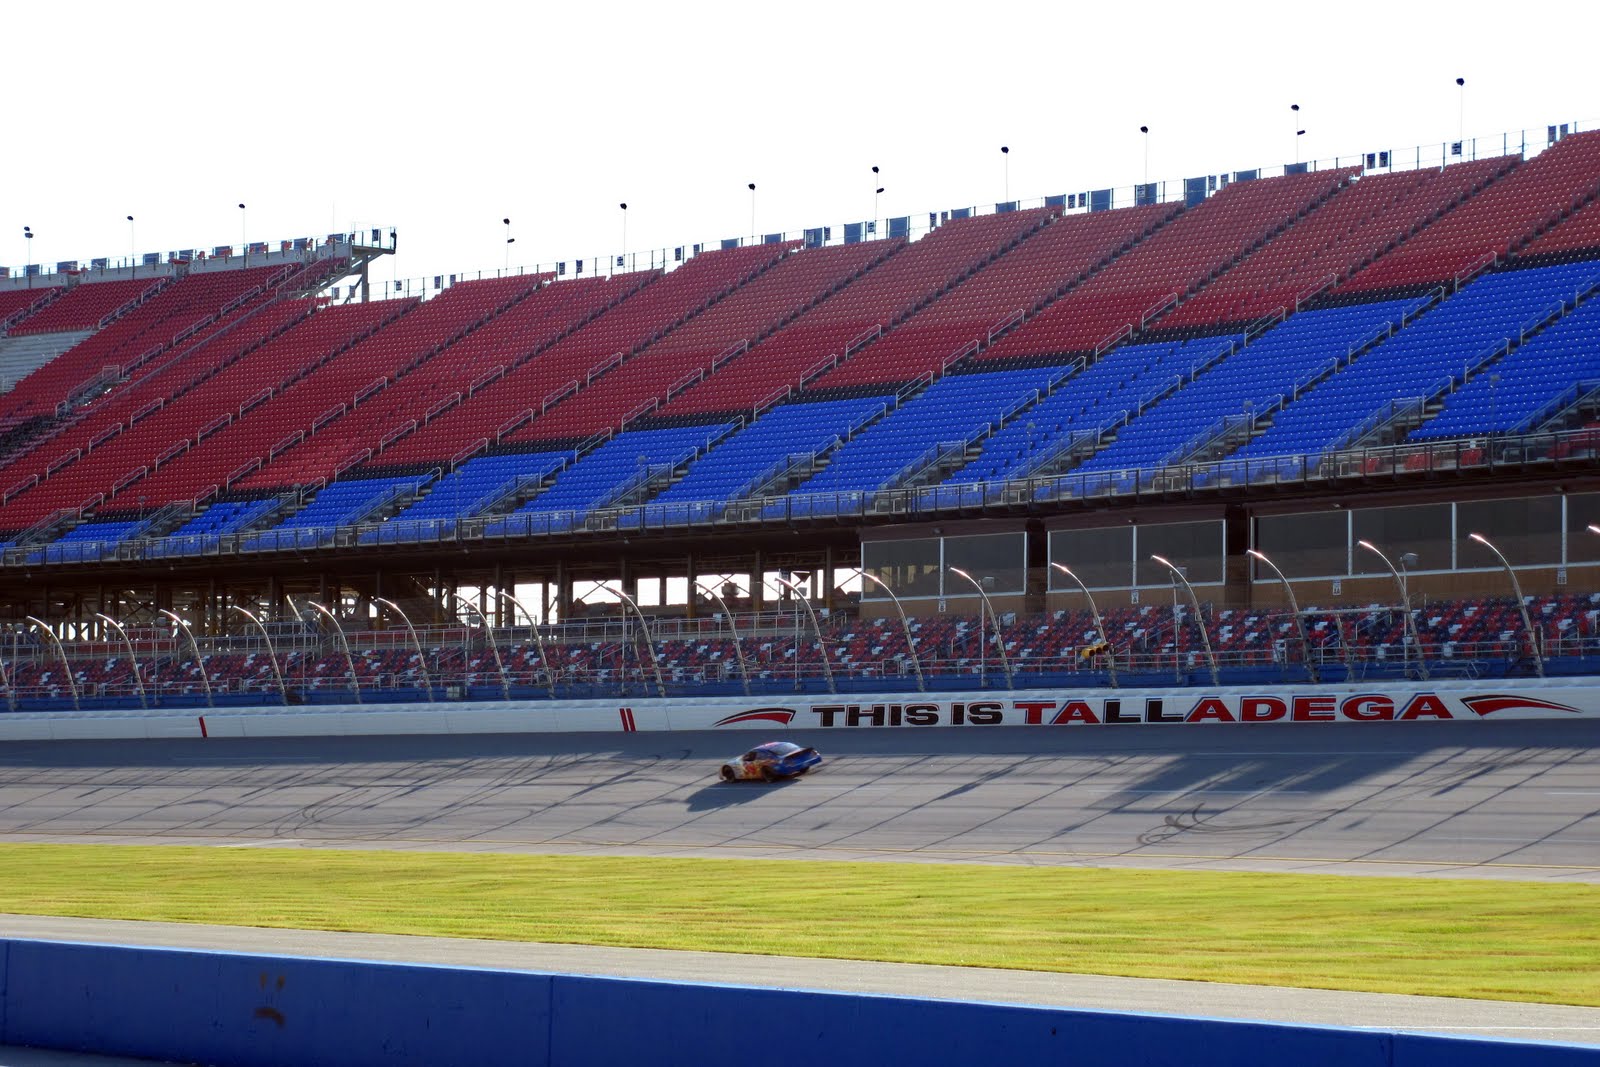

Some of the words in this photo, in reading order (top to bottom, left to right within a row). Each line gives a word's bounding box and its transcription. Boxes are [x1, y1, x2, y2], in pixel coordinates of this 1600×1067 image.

[811, 703, 940, 727] THIS
[951, 701, 1004, 725] IS
[1013, 691, 1454, 725] TALLADEGA
